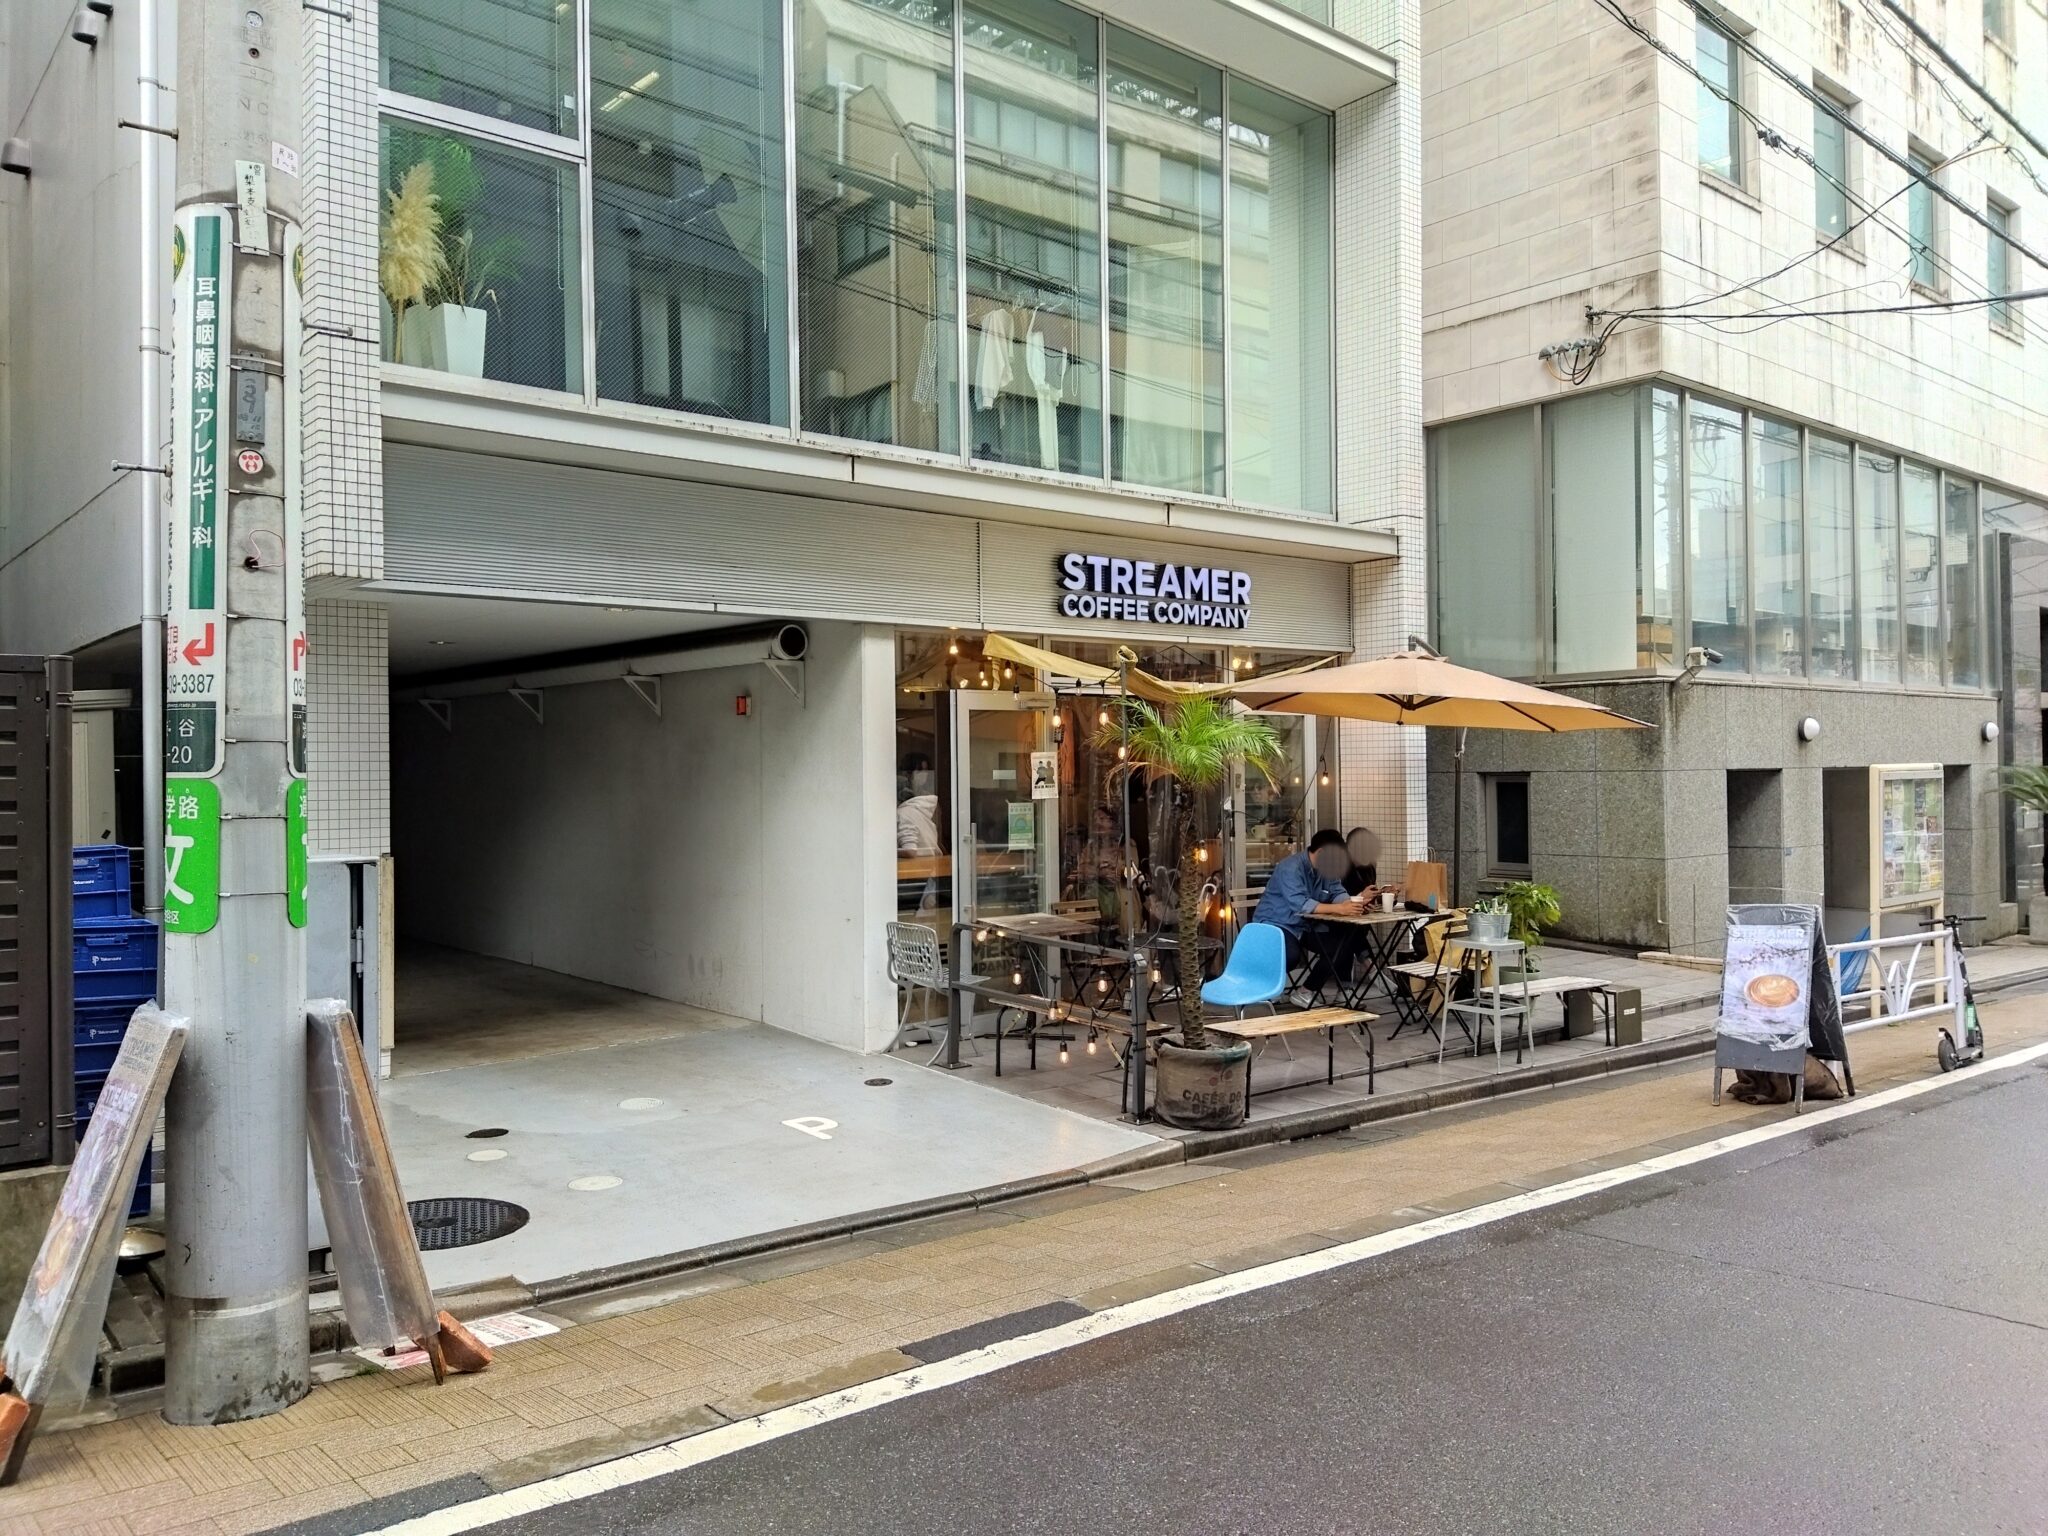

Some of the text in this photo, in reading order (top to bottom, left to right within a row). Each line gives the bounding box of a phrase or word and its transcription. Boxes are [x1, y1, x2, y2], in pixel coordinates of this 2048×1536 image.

[192, 277, 216, 549] 耳鼻咽喉科・アレルギー科
[1063, 553, 1251, 604] STREAMER
[1063, 594, 1251, 629] COFFEE COMPANY
